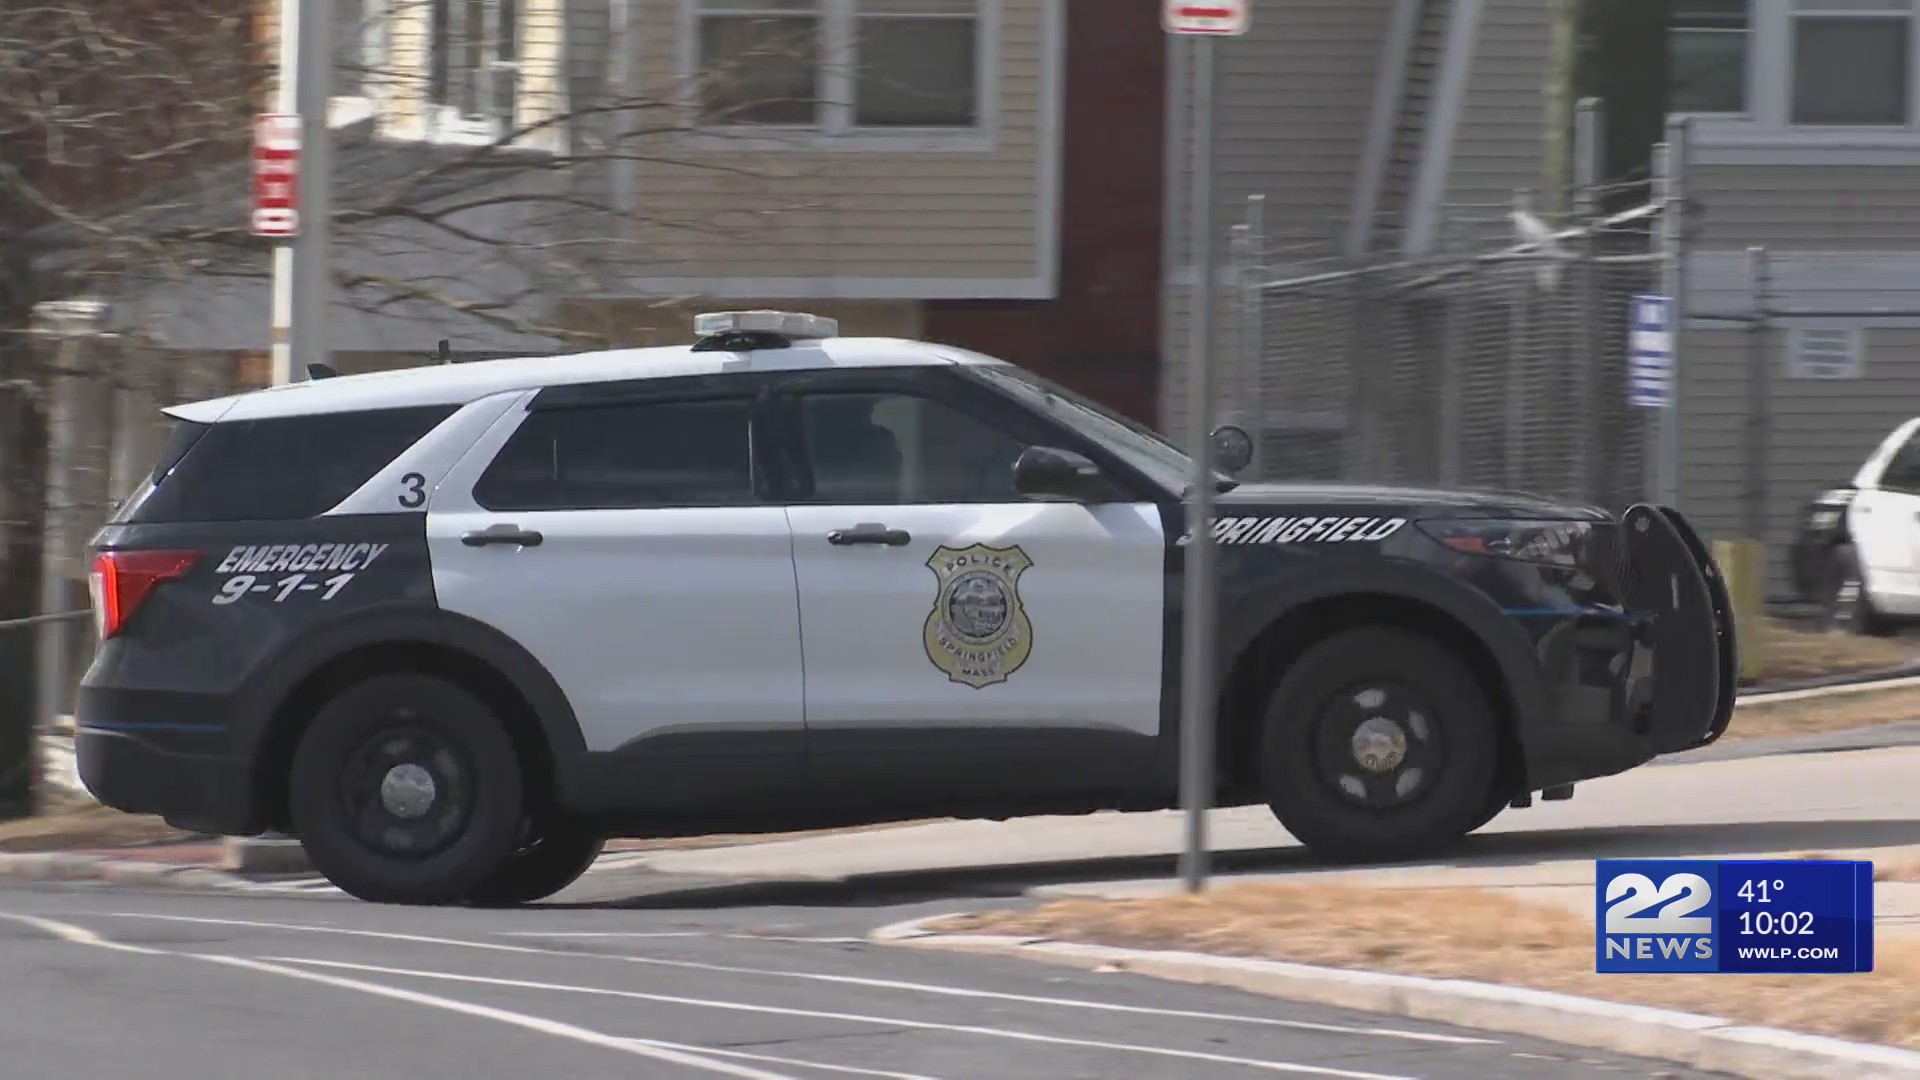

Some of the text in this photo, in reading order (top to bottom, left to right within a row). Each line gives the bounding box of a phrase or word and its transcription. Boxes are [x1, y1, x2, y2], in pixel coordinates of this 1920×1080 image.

[398, 472, 426, 508] 3
[215, 543, 389, 573] EMERGENCY
[946, 554, 1014, 573] POLICE
[212, 573, 356, 605] 9-1-1
[939, 637, 1017, 662] SPRINGFIELD
